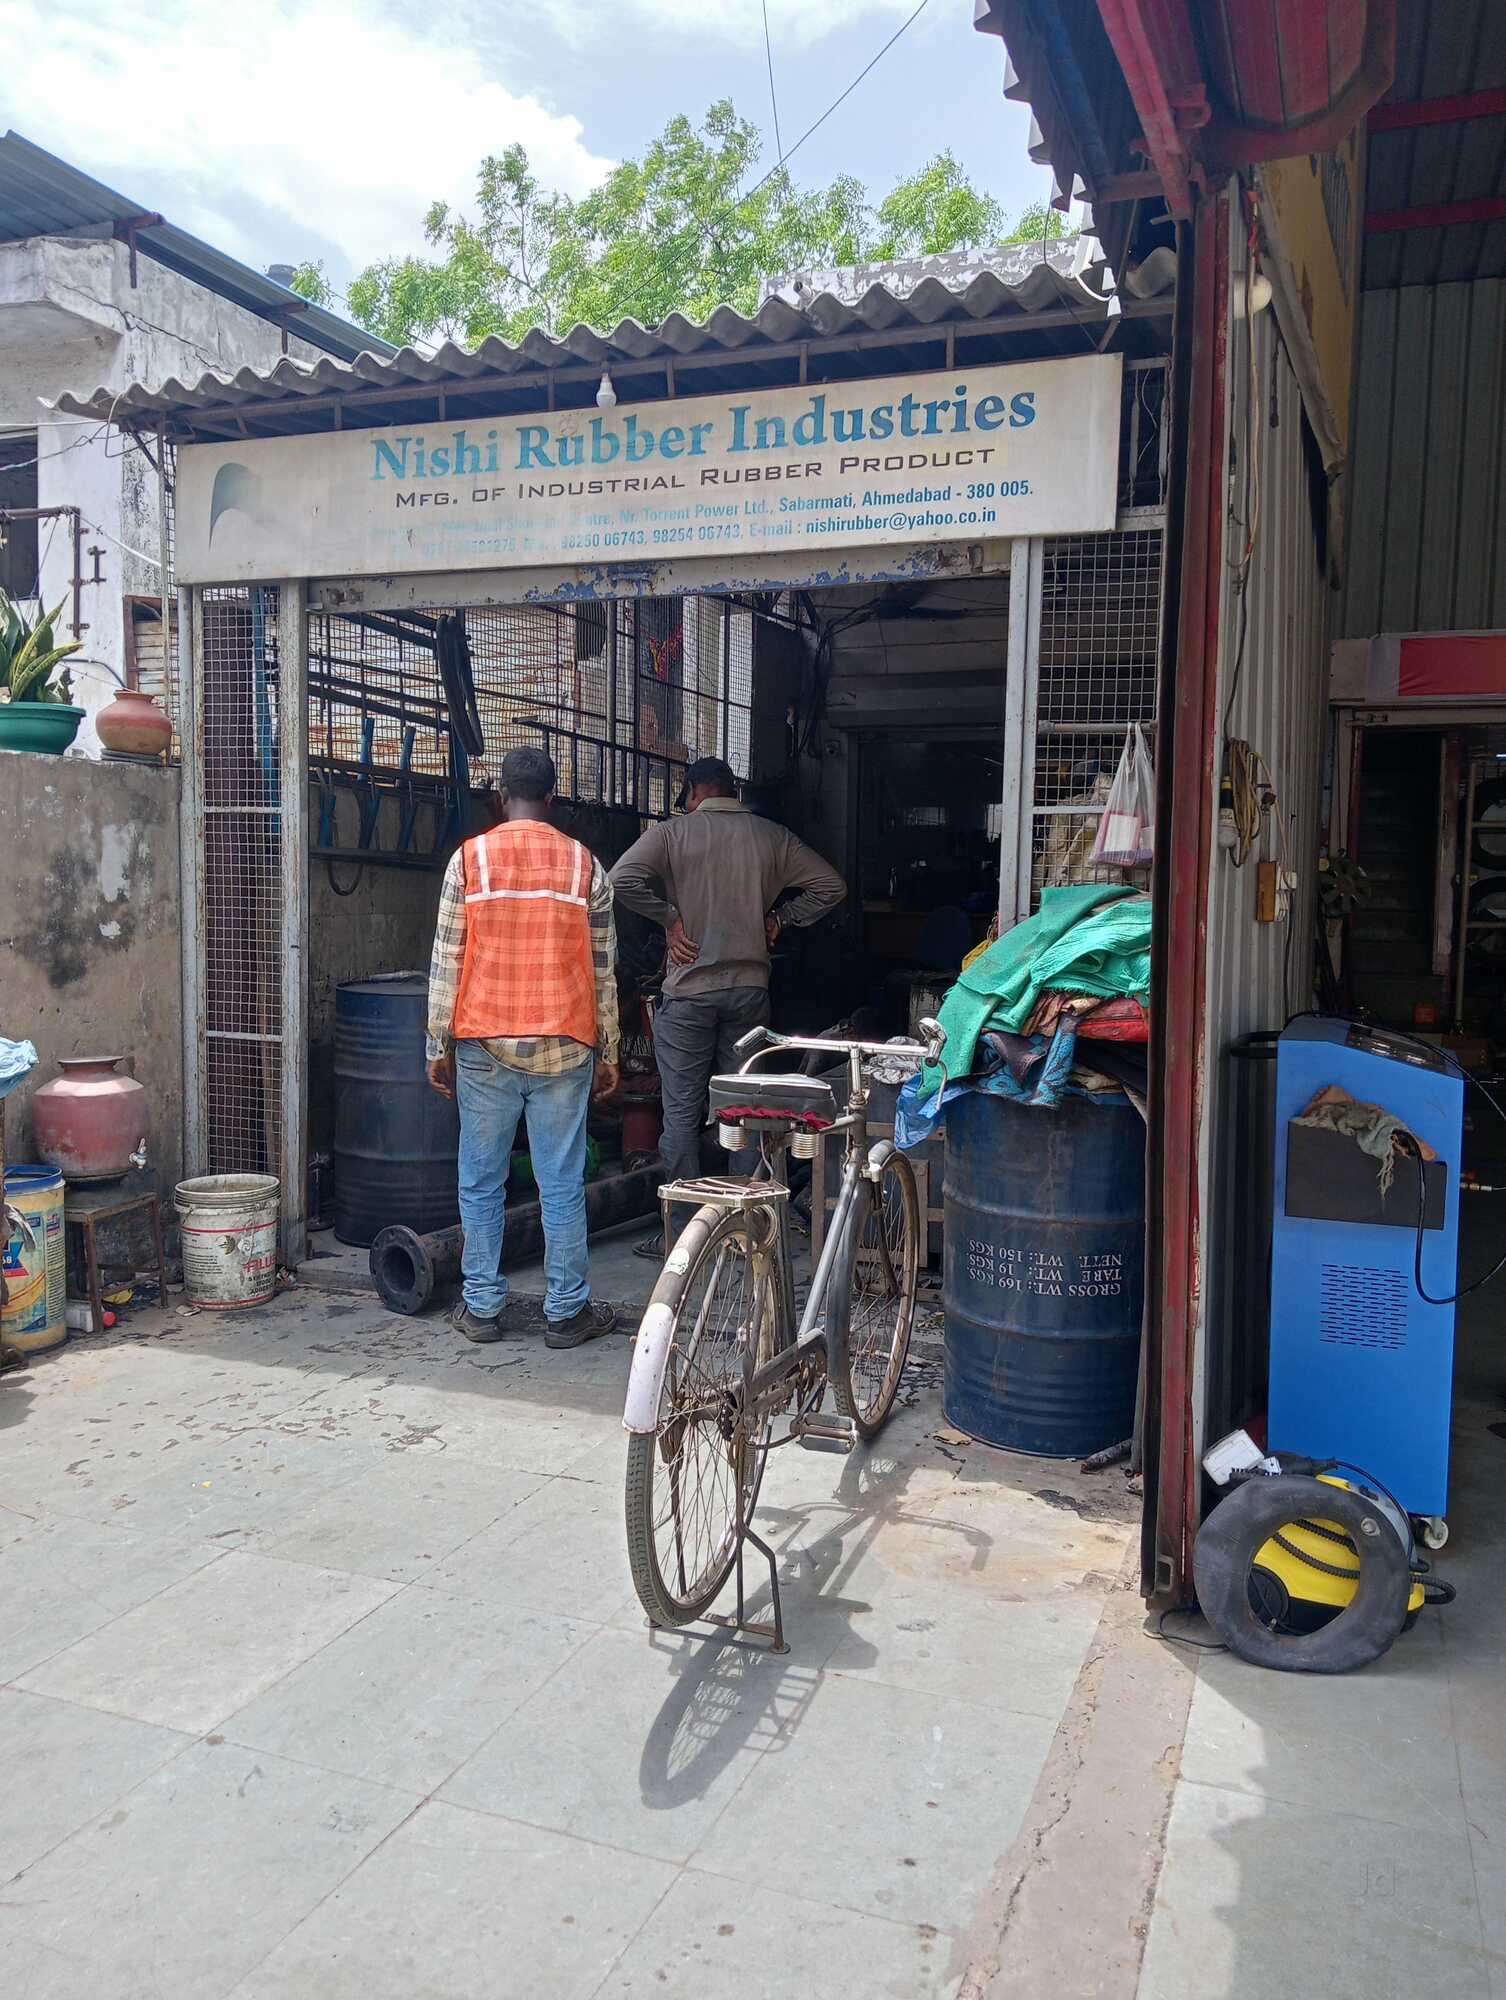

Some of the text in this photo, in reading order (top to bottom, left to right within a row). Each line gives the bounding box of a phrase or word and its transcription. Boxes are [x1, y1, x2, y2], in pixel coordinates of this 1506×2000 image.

[370, 384, 1037, 481] Nishi Rubber Industries
[396, 448, 996, 508] MFG. OF INDUSTRIAL RUBBER PRODUCT
[643, 504, 690, 522] Torrent
[694, 501, 739, 520] Power
[778, 491, 857, 513] Sabarmati,
[862, 485, 951, 507] Ahmedabad
[966, 483, 994, 500] 380
[999, 480, 1034, 498] 005.
[652, 526, 694, 543] 98254
[749, 518, 793, 537] E-mail
[805, 508, 997, 535] nishirubber@yahoo.co.in
[998, 1247, 1024, 1263] 150
[1078, 1253, 1124, 1268] NETT.
[998, 1262, 1016, 1276] 19
[1081, 1267, 1123, 1283] TARE
[998, 1277, 1023, 1292] 169
[1068, 1282, 1122, 1297] GROSS
